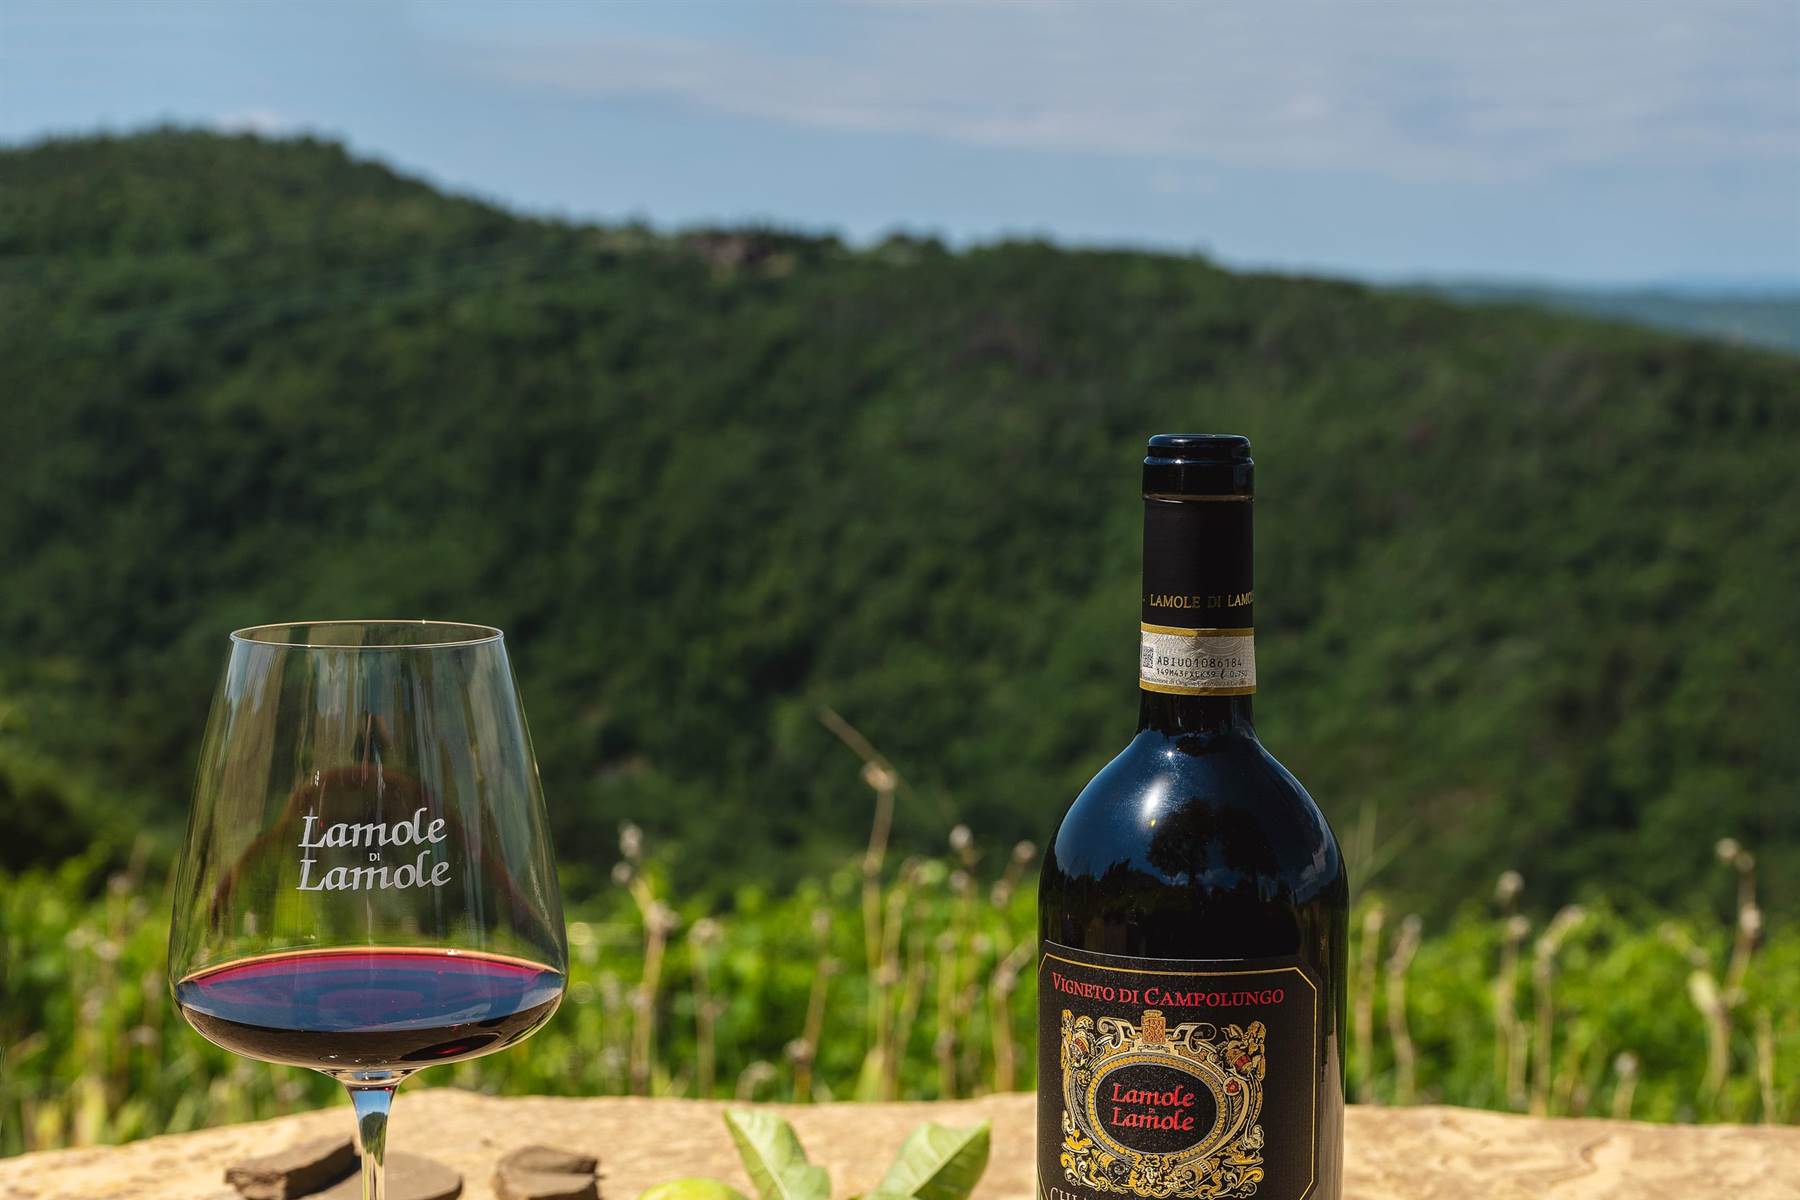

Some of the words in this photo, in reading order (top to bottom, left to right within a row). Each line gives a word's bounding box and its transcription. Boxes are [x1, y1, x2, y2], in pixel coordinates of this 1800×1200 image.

[1150, 594, 1201, 609] LAMOLE
[1207, 596, 1221, 609] DI
[298, 807, 448, 848] Lamole
[368, 852, 381, 862] DI
[295, 850, 452, 891] Lamole
[1051, 971, 1115, 1002] VIGNETO
[1118, 988, 1138, 1006] DI
[1143, 987, 1284, 1007] CAMPOLUNGO
[1111, 1083, 1196, 1107] Lamole
[1111, 1106, 1196, 1131] Lamole
